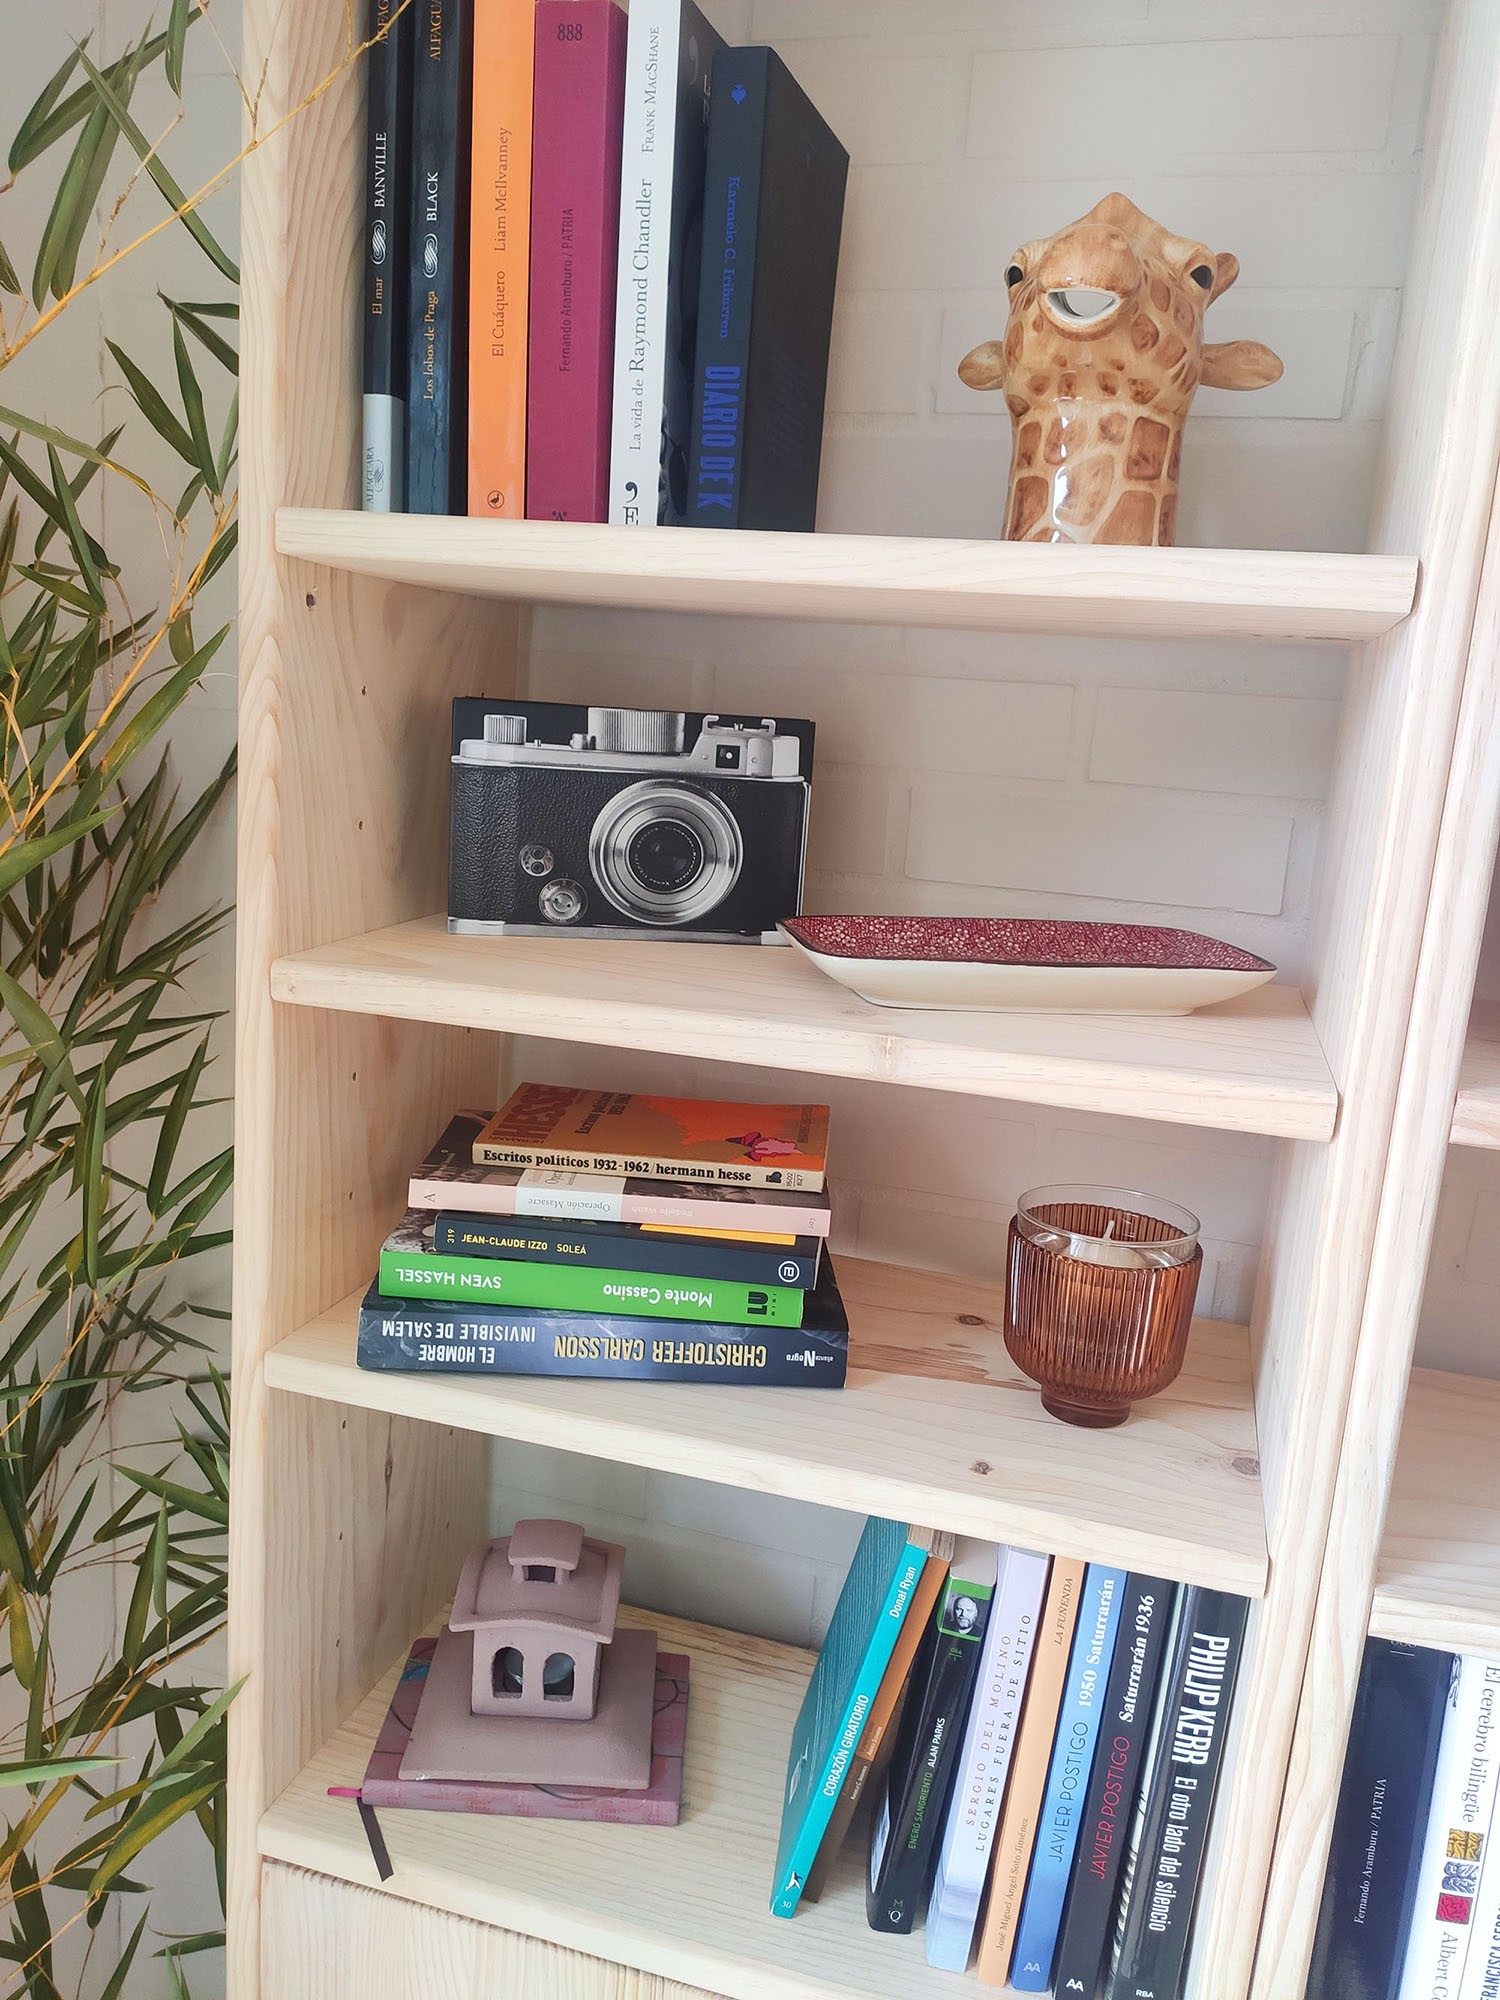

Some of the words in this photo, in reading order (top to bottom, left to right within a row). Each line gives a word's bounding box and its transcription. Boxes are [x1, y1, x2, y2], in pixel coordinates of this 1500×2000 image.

[557, 23, 583, 41] 888
[374, 131, 387, 208] BANVILLE
[495, 127, 513, 212] McIlvanney
[426, 171, 439, 222] BLACK
[494, 214, 507, 252] Liam
[562, 208, 574, 250] PATRIA
[632, 178, 654, 271] Chandler
[374, 277, 384, 299] mar
[560, 259, 573, 316] Aramburu
[372, 303, 383, 315] El
[424, 290, 439, 323] Praga
[493, 270, 509, 339] Cuáquero
[424, 326, 435, 341] de
[629, 277, 651, 372] Raymond
[423, 343, 435, 375] lobos
[492, 343, 504, 357] El
[559, 316, 572, 372] Fernando
[423, 375, 434, 400] Los
[632, 379, 644, 397] de
[631, 400, 643, 431] vida
[701, 366, 741, 448] DIARIO
[629, 433, 641, 451] La
[698, 455, 736, 485] DE
[697, 492, 733, 510] K
[483, 1149, 533, 1164] Escritos
[718, 1168, 752, 1181] hesse
[527, 1197, 564, 1210] Masacre
[567, 1199, 611, 1213] Operación
[446, 1228, 456, 1244] 319
[461, 1233, 526, 1249] JEAN-CLAUDE
[528, 1242, 548, 1251] IZZO
[556, 1243, 587, 1255] SOLEÁ
[395, 1268, 456, 1286] HASSEL
[460, 1273, 503, 1289] SVEN
[603, 1284, 661, 1304] Cassino
[665, 1289, 713, 1308] Monte
[382, 1320, 433, 1339] SALEM
[434, 1322, 454, 1339] DE
[459, 1323, 536, 1342] INVISIBLE
[418, 1344, 476, 1363] HOMBRE
[481, 1347, 496, 1364] EL
[553, 1335, 646, 1362] CARLSSON
[652, 1339, 768, 1368] CHRISTOFFER
[889, 1589, 907, 1619] Donal
[899, 1566, 917, 1591] Ryan
[1086, 1578, 1115, 1665] Saturrarán
[1054, 1631, 1064, 1646] LA
[1119, 1636, 1148, 1724] Saturrarán
[1134, 1594, 1155, 1634] 1936
[1183, 1631, 1231, 1706] PHILIP
[1078, 1669, 1098, 1708] 1950
[933, 1716, 947, 1745] PARKS
[966, 1762, 986, 1826] SERGIO
[981, 1719, 995, 1751] DEL
[989, 1635, 1011, 1708] MOLINO
[976, 1776, 999, 1852] LUGARES
[994, 1710, 1013, 1765] FUERA
[1006, 1677, 1020, 1699] DE
[1013, 1614, 1032, 1667] SITIO
[1171, 1706, 1217, 1766] KERR
[1473, 1688, 1496, 1754] cerebro
[823, 1747, 850, 1797] CORAZÓN
[842, 1694, 870, 1750] GIRATORIO
[927, 1744, 940, 1768] ALAN
[1060, 1721, 1089, 1801] POSTIGO
[1101, 1736, 1131, 1817] POSTIGO
[1173, 1775, 1198, 1790] El
[1461, 1756, 1490, 1823] bilingüe
[908, 1822, 921, 1850] ENERO
[915, 1771, 934, 1822] SANGRIENTO
[1168, 1792, 1192, 1821] otro
[1370, 1778, 1387, 1820] PATRIA
[1048, 1805, 1073, 1863] JAVIER
[1162, 1823, 1189, 1854] lado
[1011, 1854, 1021, 1875] Soto
[1089, 1820, 1115, 1880] JAVIER
[1362, 1829, 1379, 1879] Aramburu
[1157, 1856, 1183, 1879] del
[999, 1901, 1013, 1931] Miguel
[1148, 1879, 1177, 1933] silencio
[1353, 1880, 1371, 1925] Fernando
[996, 1930, 1006, 1952] José
[1434, 1931, 1459, 1981] Albert
[1480, 1946, 1500, 2000] RANCISC
[1135, 1988, 1154, 1999] RBA
[1431, 1985, 1449, 2000] C
